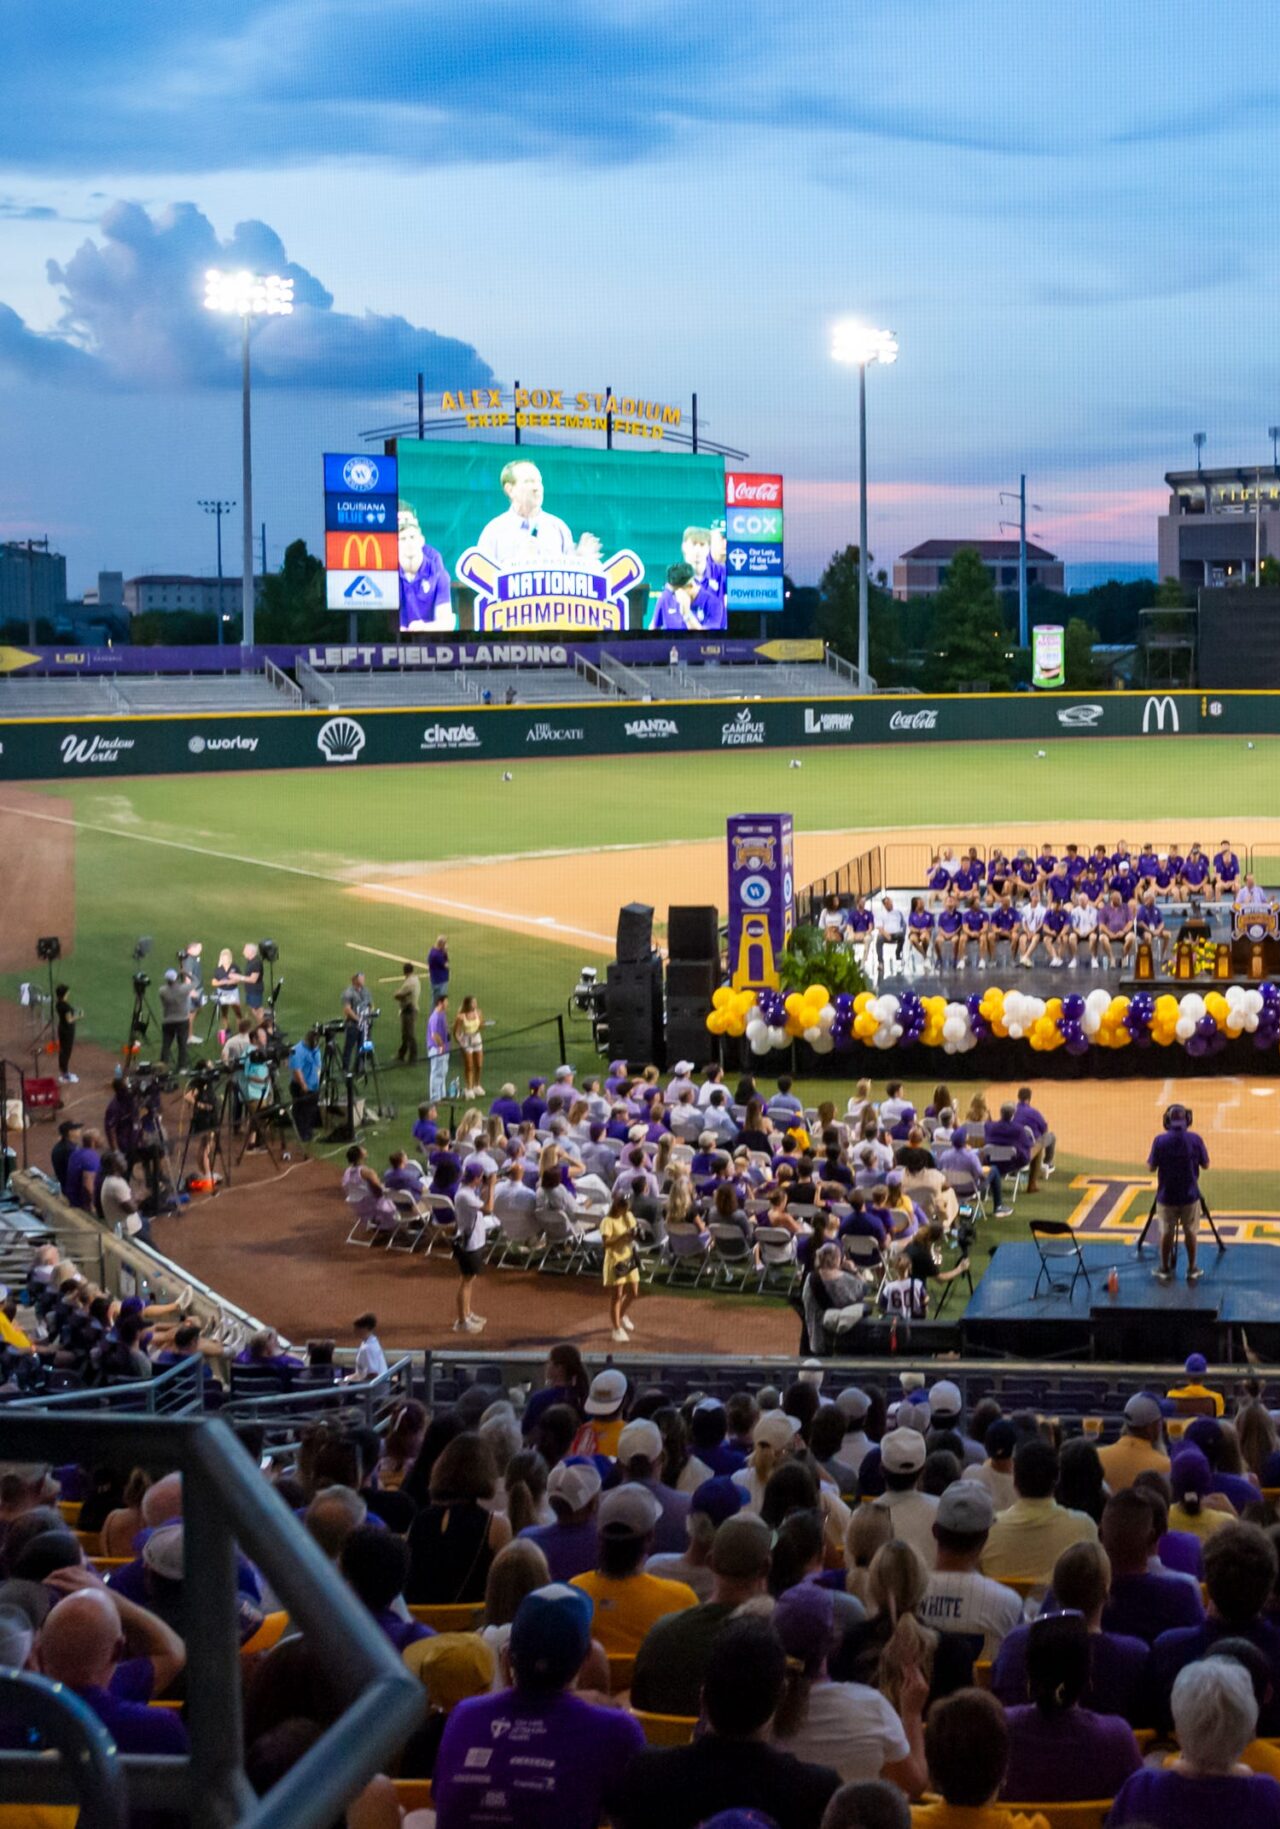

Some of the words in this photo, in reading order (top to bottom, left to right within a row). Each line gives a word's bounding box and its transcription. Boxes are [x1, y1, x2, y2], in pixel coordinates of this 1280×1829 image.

[441, 389, 502, 411] ALEX
[515, 388, 564, 410] BOX
[575, 391, 681, 427] STADIUM
[466, 413, 509, 429] SKIP
[516, 412, 607, 431] BERTMAN
[614, 419, 664, 440] FIELD
[337, 501, 386, 511] LOUISIANA
[337, 511, 364, 524] BLUE
[733, 515, 777, 534] COX
[507, 571, 598, 599] NATIONAL
[492, 602, 614, 631] CHAMPIONS
[55, 653, 85, 664] LSU
[308, 647, 376, 667] LEFT
[382, 645, 454, 666] FIELD
[460, 644, 568, 665] LANDING
[526, 728, 584, 741] ADVOCATE
[624, 718, 679, 736] MANDA
[722, 721, 765, 735] CAMPUS
[207, 735, 259, 752] worley
[721, 732, 765, 745] FEDERAL
